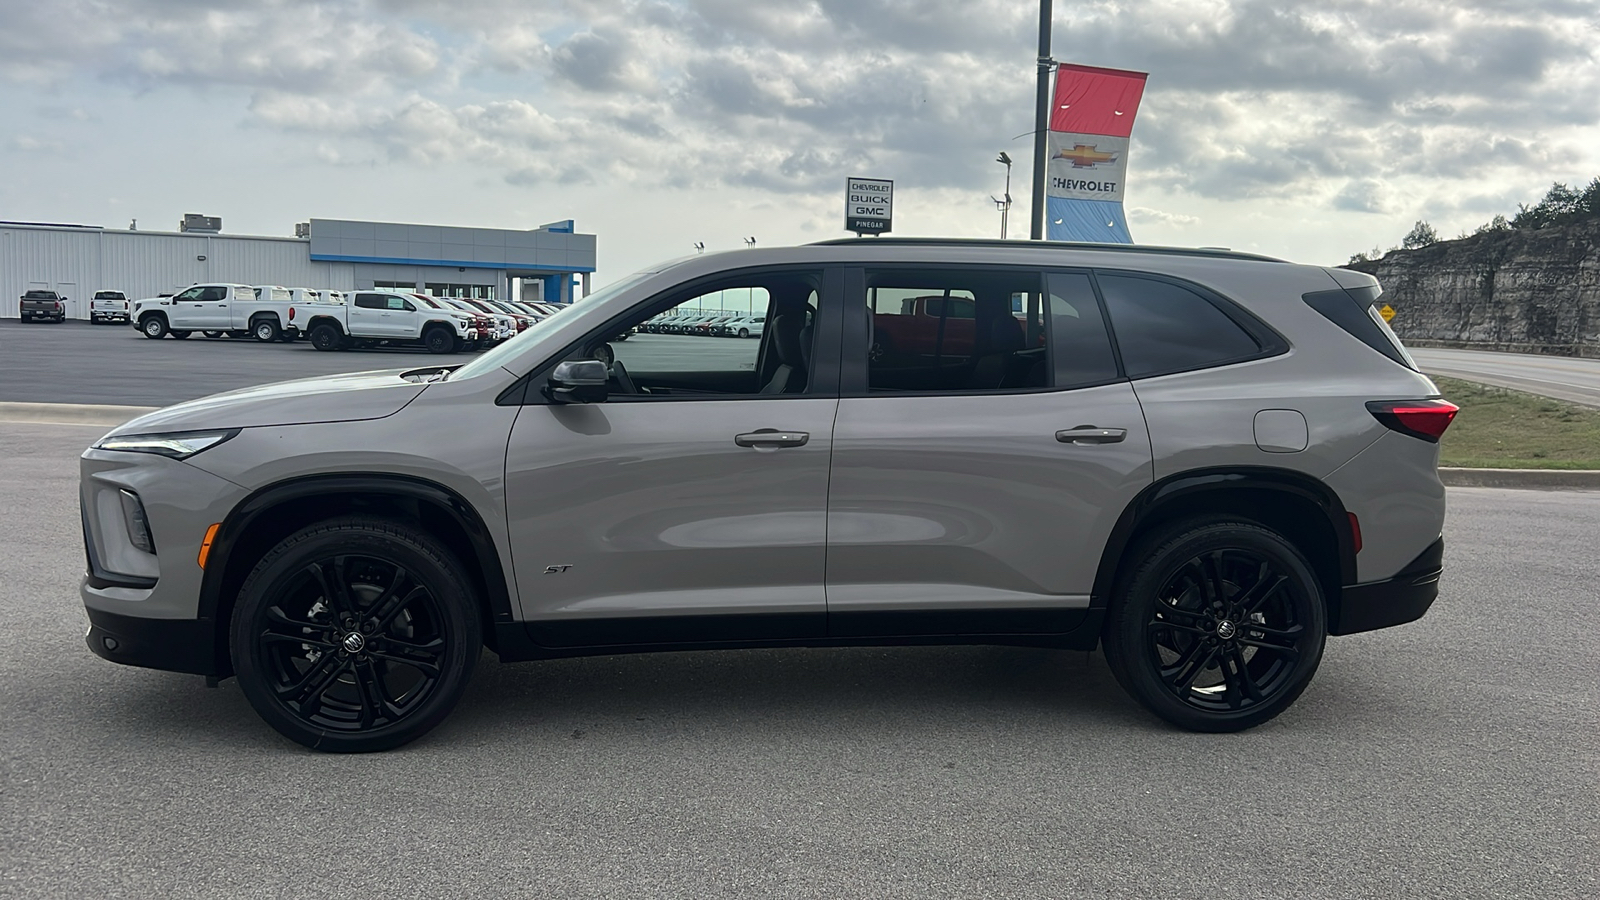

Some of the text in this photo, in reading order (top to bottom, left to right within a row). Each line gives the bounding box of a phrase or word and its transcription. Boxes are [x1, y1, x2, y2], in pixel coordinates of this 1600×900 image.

[852, 183, 890, 192] CHEVROLET
[851, 195, 889, 204] BUICK
[856, 207, 884, 215] GMC
[544, 564, 573, 574] ST
